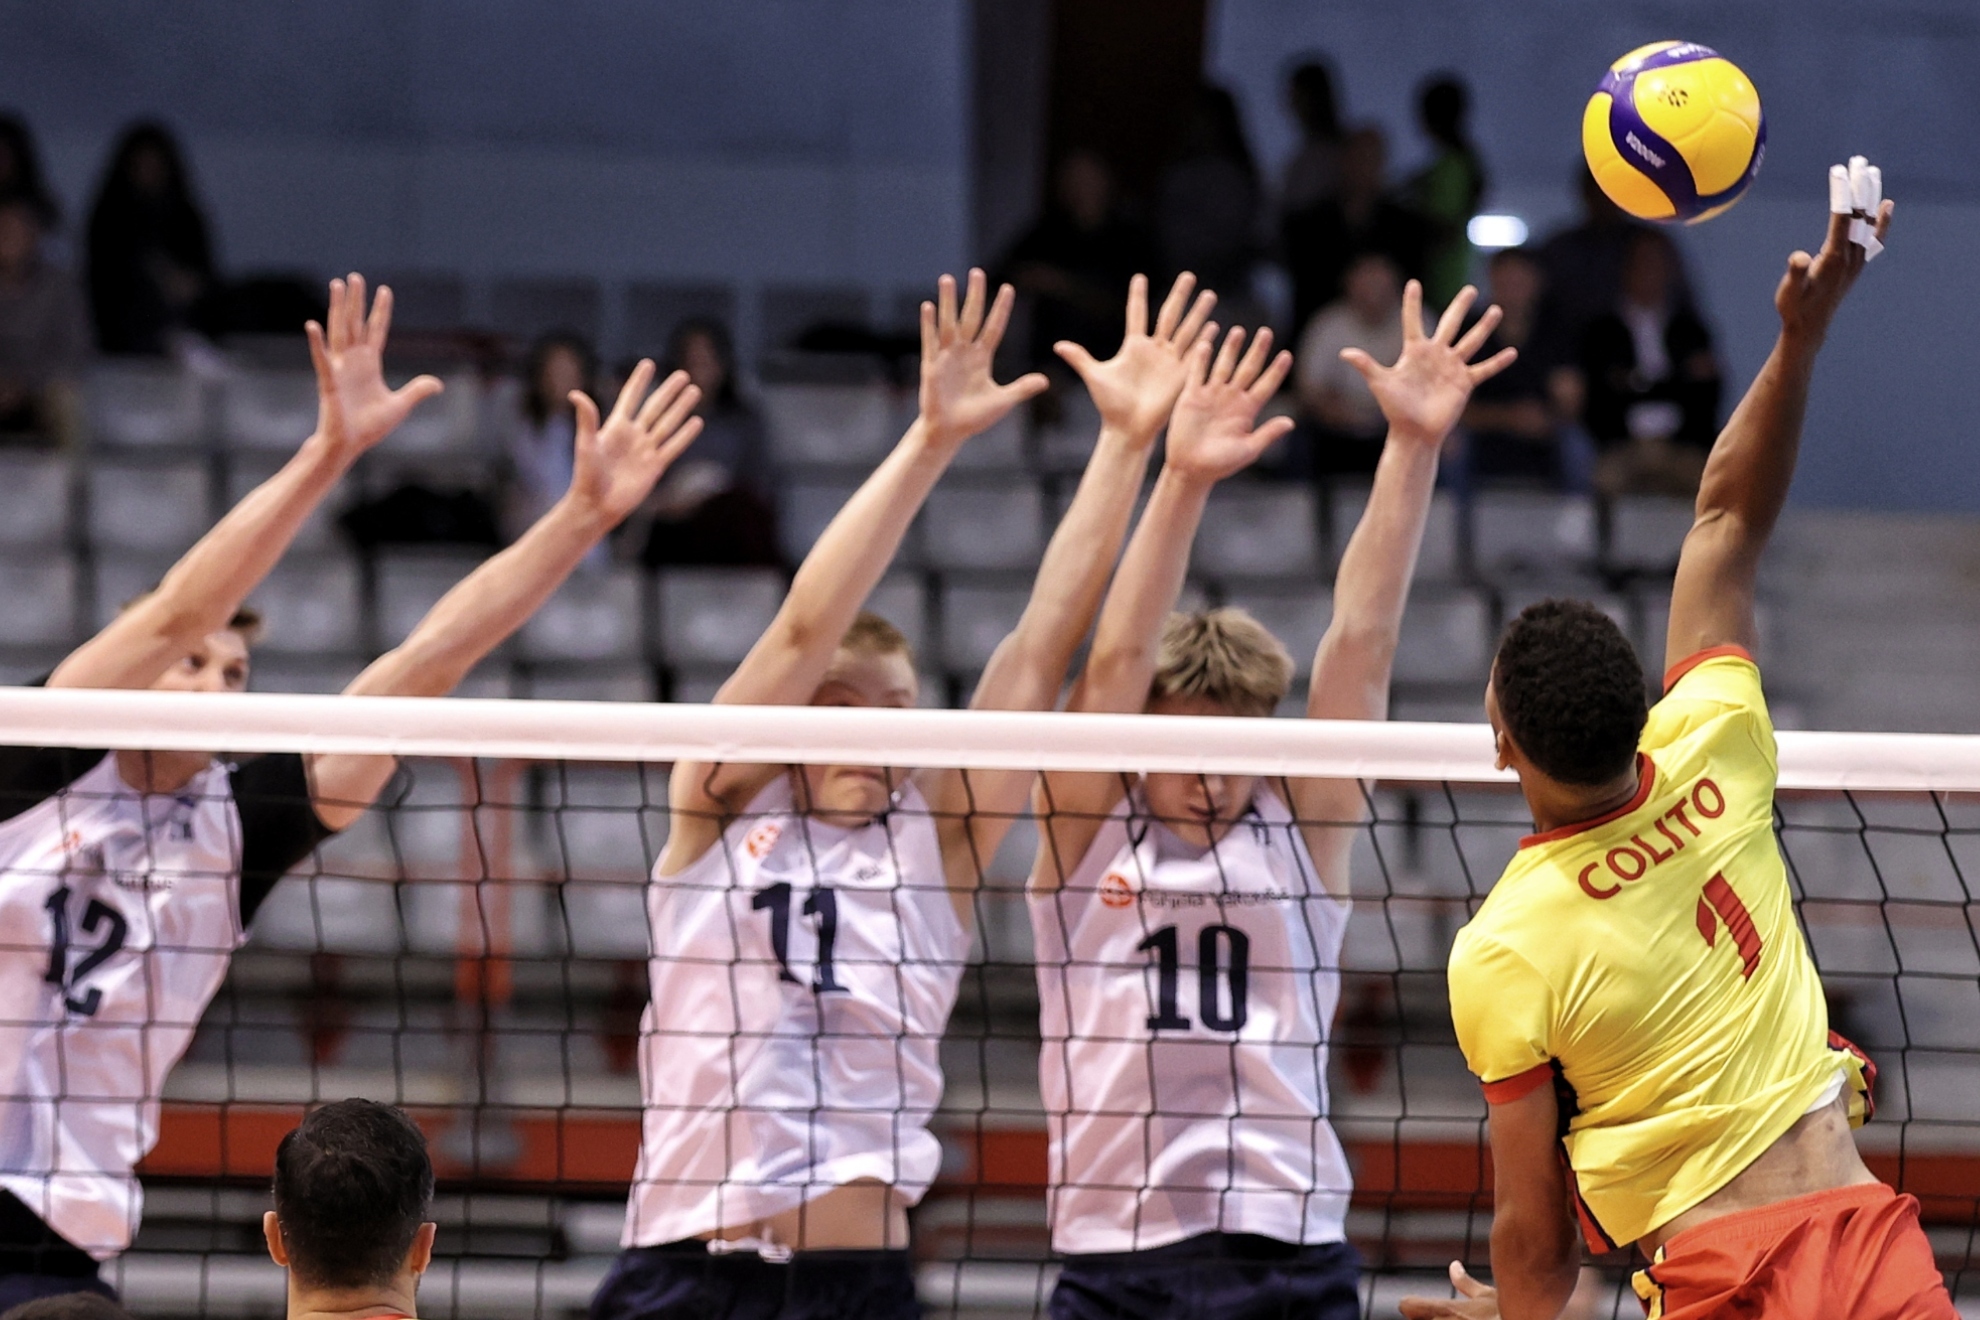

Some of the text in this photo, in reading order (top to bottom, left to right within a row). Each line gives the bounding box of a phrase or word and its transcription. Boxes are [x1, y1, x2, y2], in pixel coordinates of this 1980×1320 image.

[1578, 777, 1725, 900] COLITO
[44, 886, 127, 1016] 12
[752, 882, 851, 994] 11
[1138, 925, 1249, 1032] 10
[1696, 870, 1763, 983] 1
